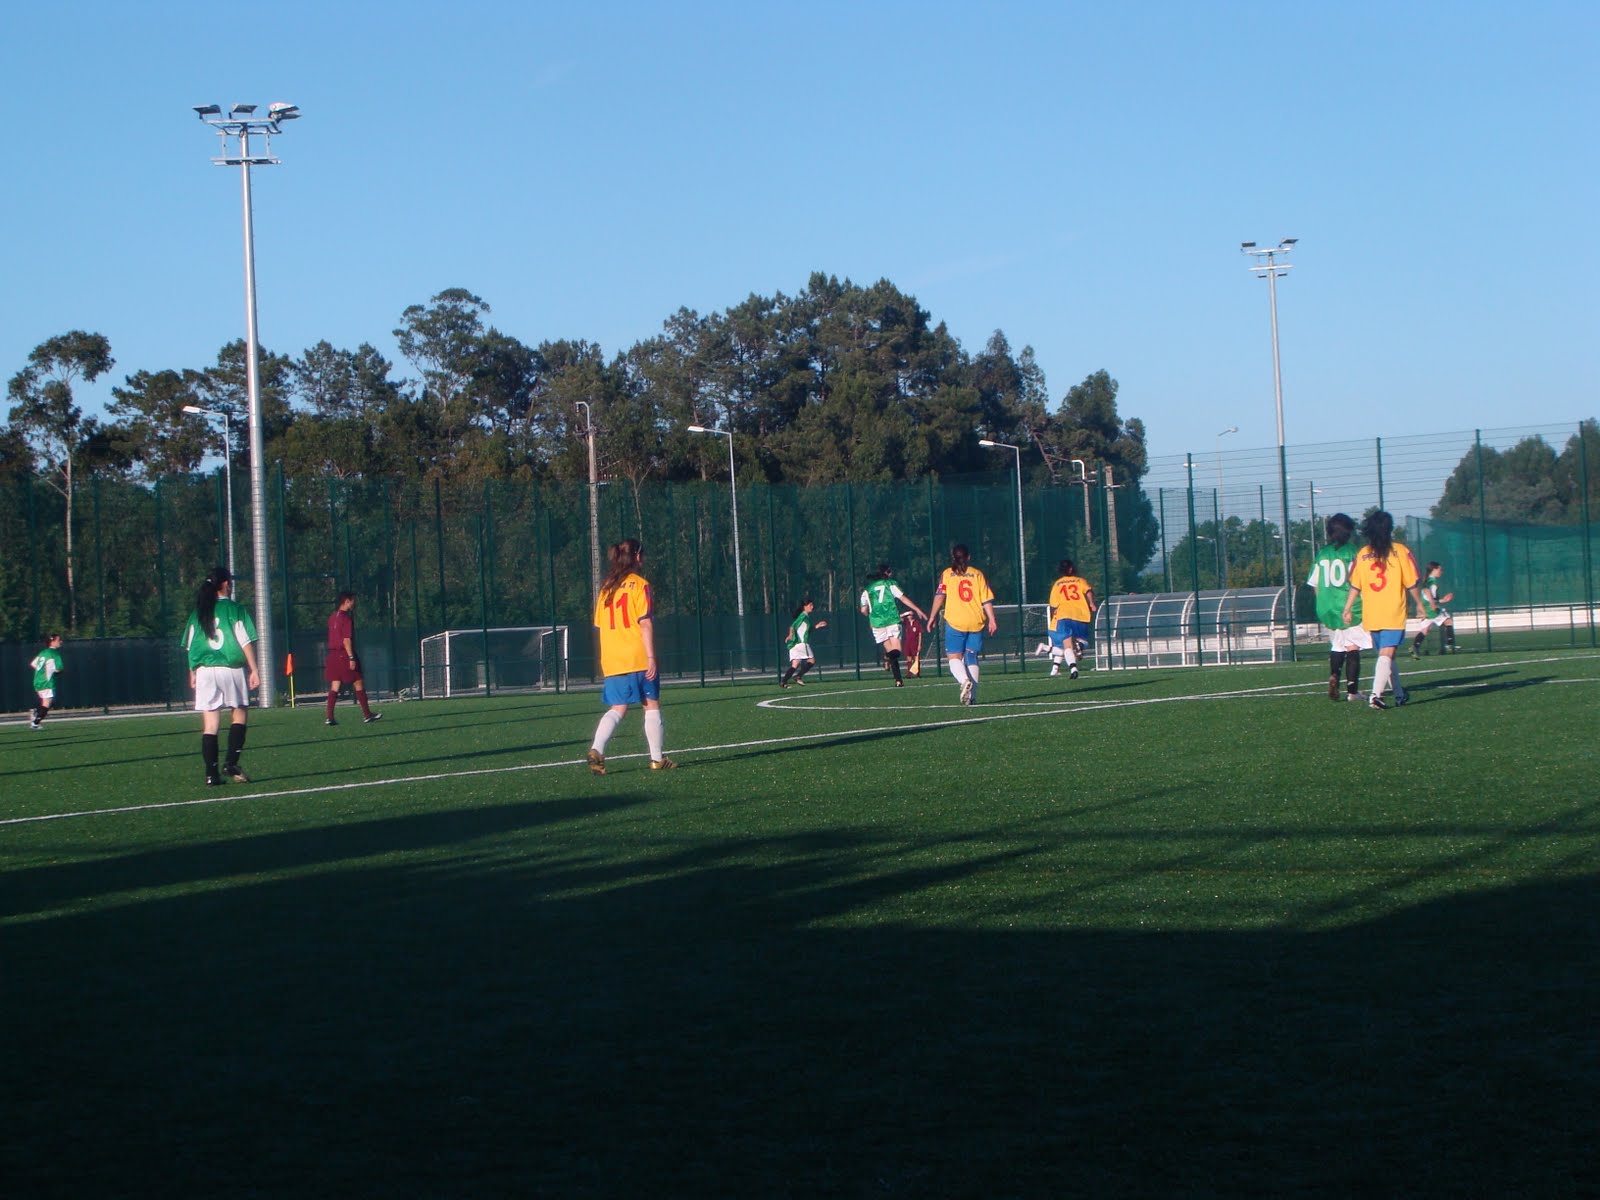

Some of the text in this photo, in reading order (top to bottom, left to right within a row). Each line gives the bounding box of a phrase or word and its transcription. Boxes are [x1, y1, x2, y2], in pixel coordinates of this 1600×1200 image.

[1320, 559, 1346, 587] 10
[1370, 561, 1387, 592] 3
[874, 585, 885, 603] 7
[959, 579, 973, 602] 6
[1060, 584, 1080, 601] 13
[604, 592, 631, 630] 11
